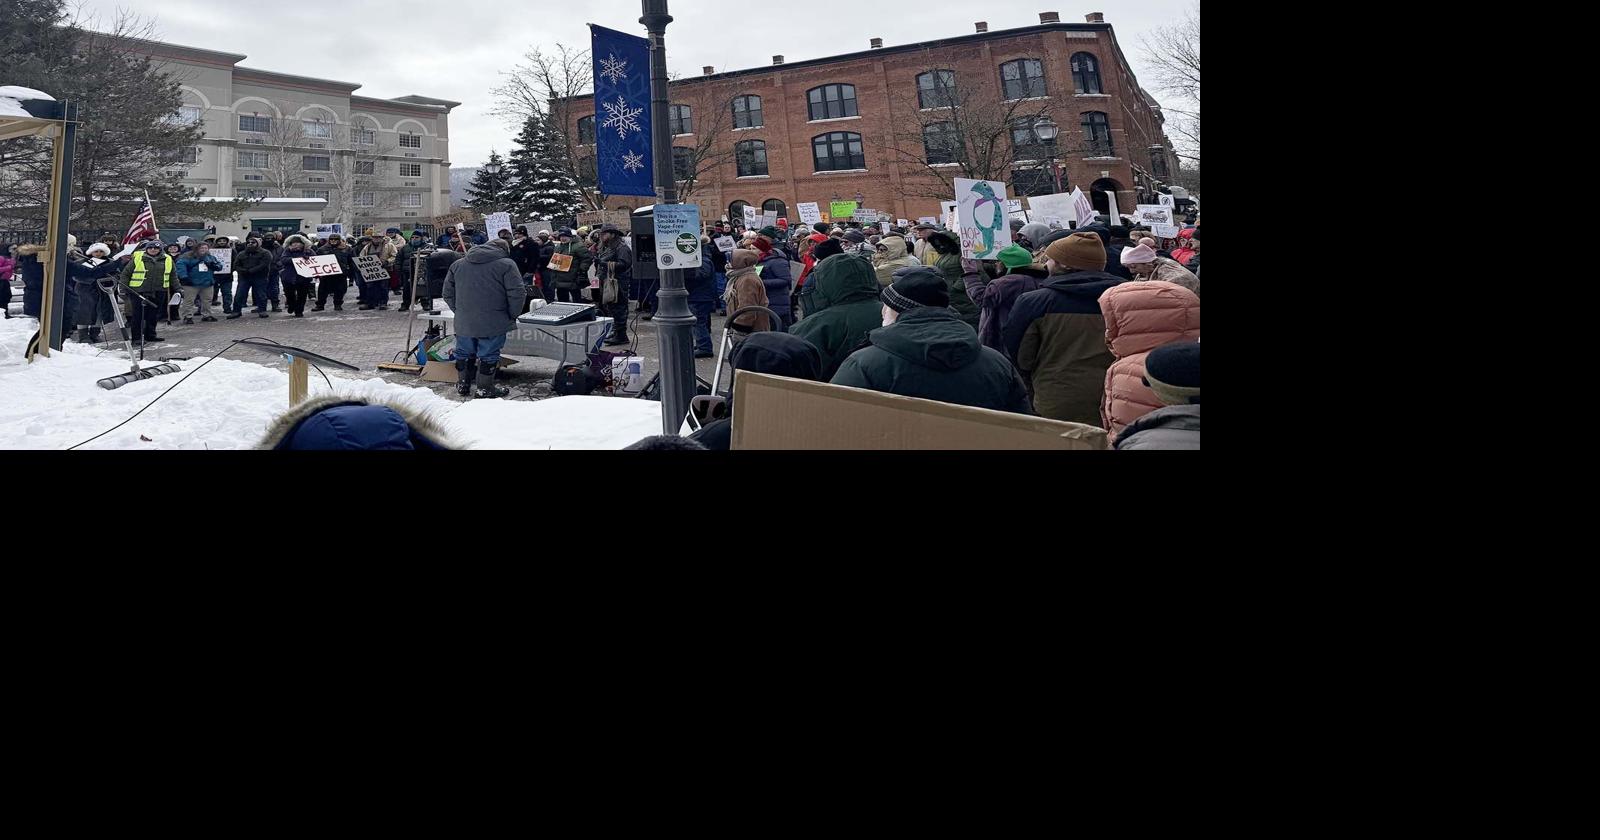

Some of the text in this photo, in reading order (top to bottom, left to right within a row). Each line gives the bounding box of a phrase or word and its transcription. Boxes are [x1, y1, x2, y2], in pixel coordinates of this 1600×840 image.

[961, 227, 980, 240] HOP
[962, 239, 974, 249] ON
[295, 257, 317, 270] Melt
[309, 262, 340, 276] ICE
[358, 261, 381, 270] KINGS
[363, 271, 388, 281] WARS
